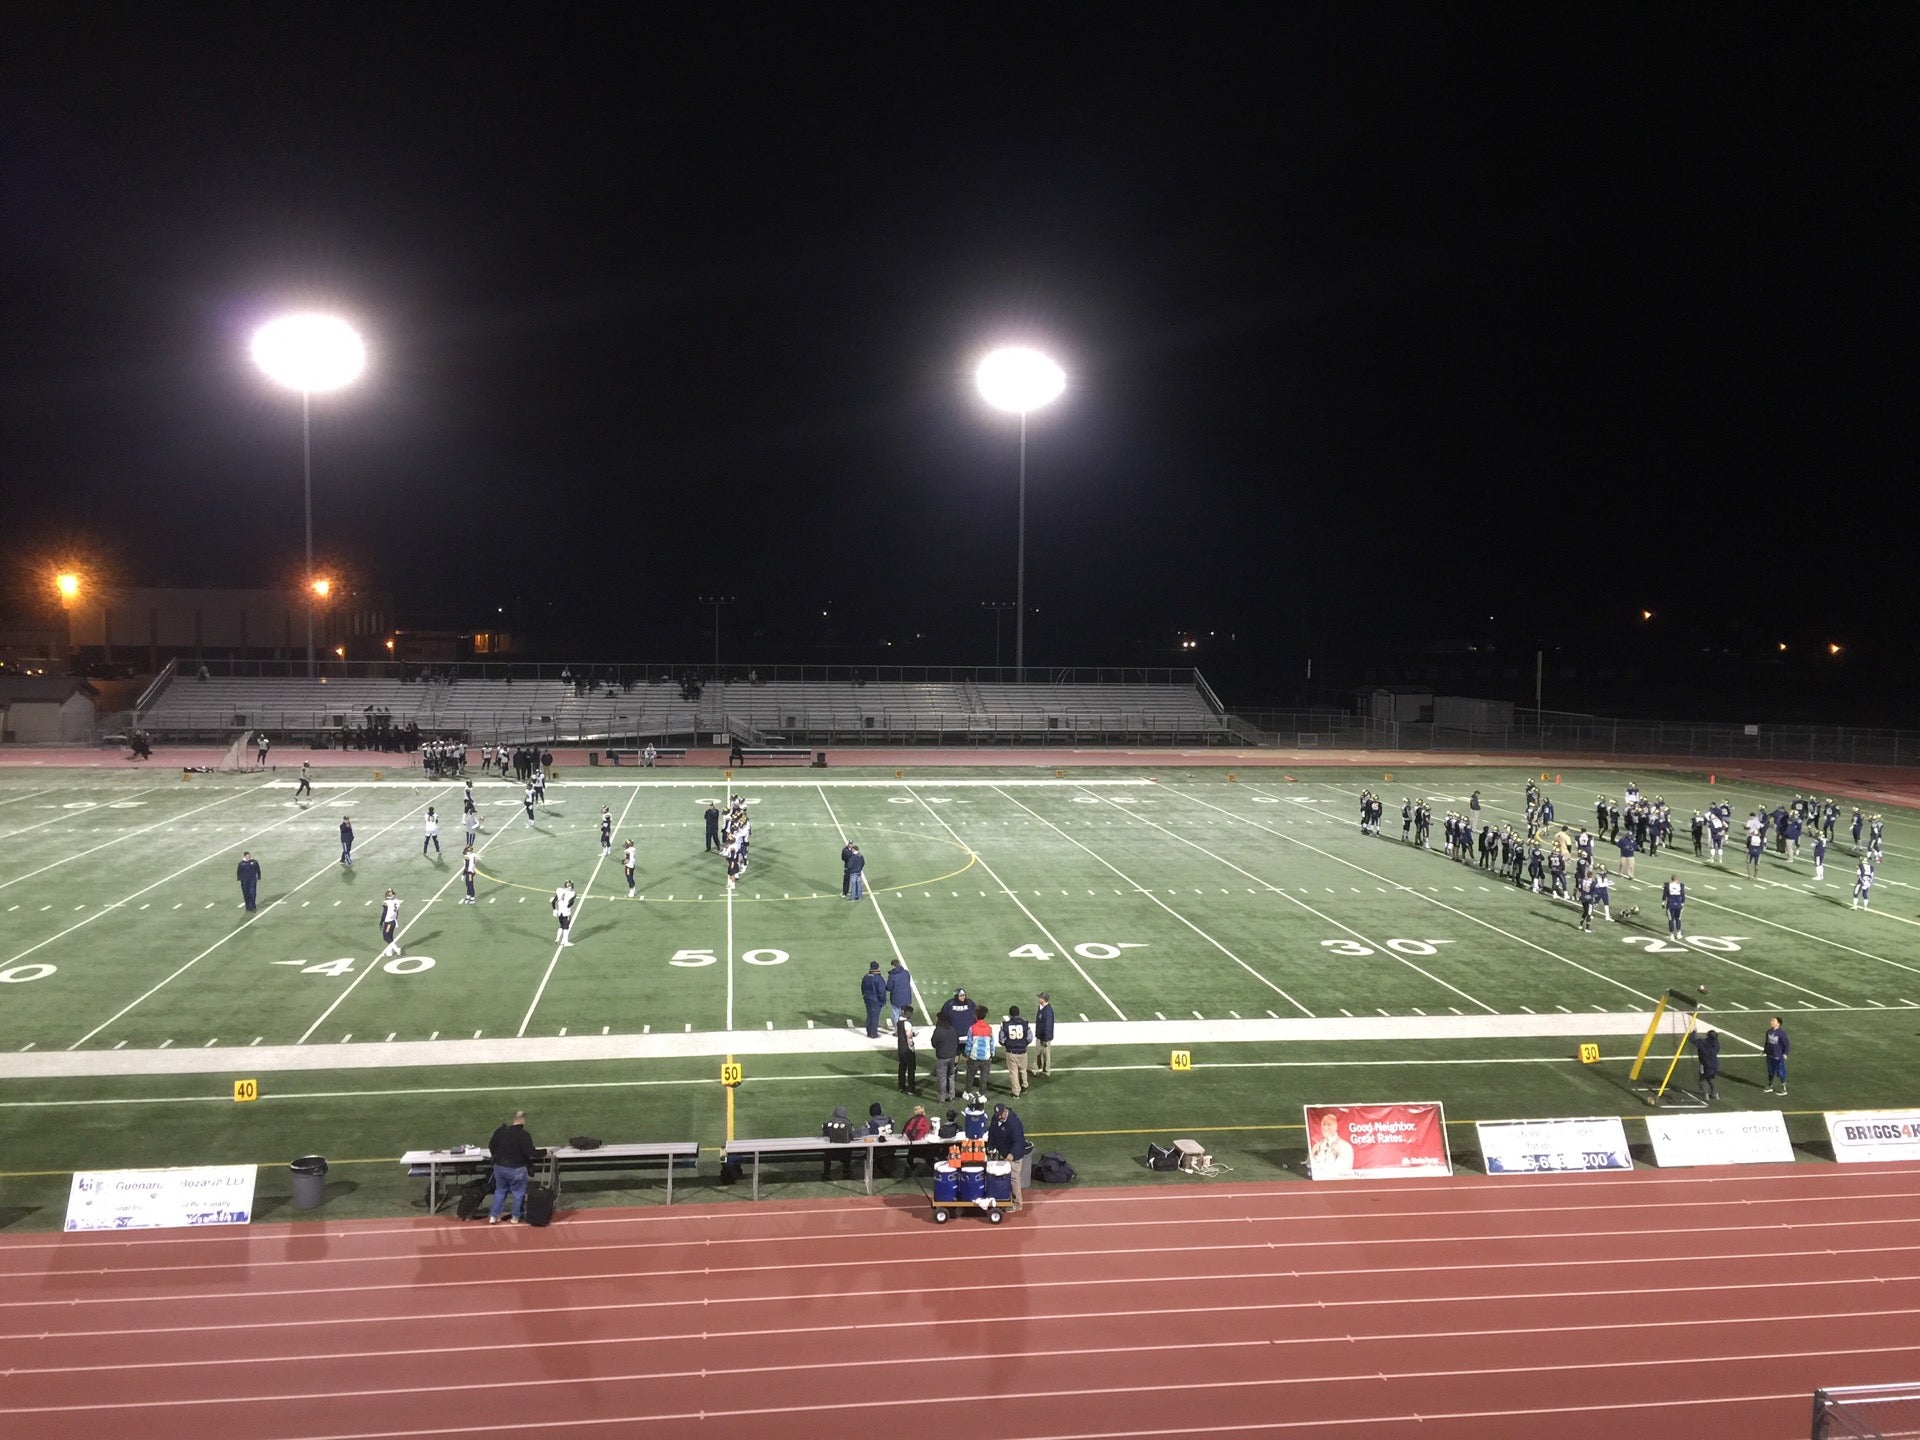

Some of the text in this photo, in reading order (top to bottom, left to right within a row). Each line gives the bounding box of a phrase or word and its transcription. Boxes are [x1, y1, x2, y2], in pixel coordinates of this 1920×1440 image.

[1008, 942, 1121, 961] 40
[1320, 938, 1438, 956] 30
[1622, 935, 1742, 953] 20
[300, 956, 436, 976] 40
[668, 948, 790, 968] 50
[1008, 1025, 1024, 1040] 58
[1174, 1053, 1188, 1067] 40
[1584, 1046, 1597, 1060] 30
[724, 1066, 738, 1081] 50
[237, 1082, 254, 1099] 40
[1350, 1132, 1376, 1145] Great
